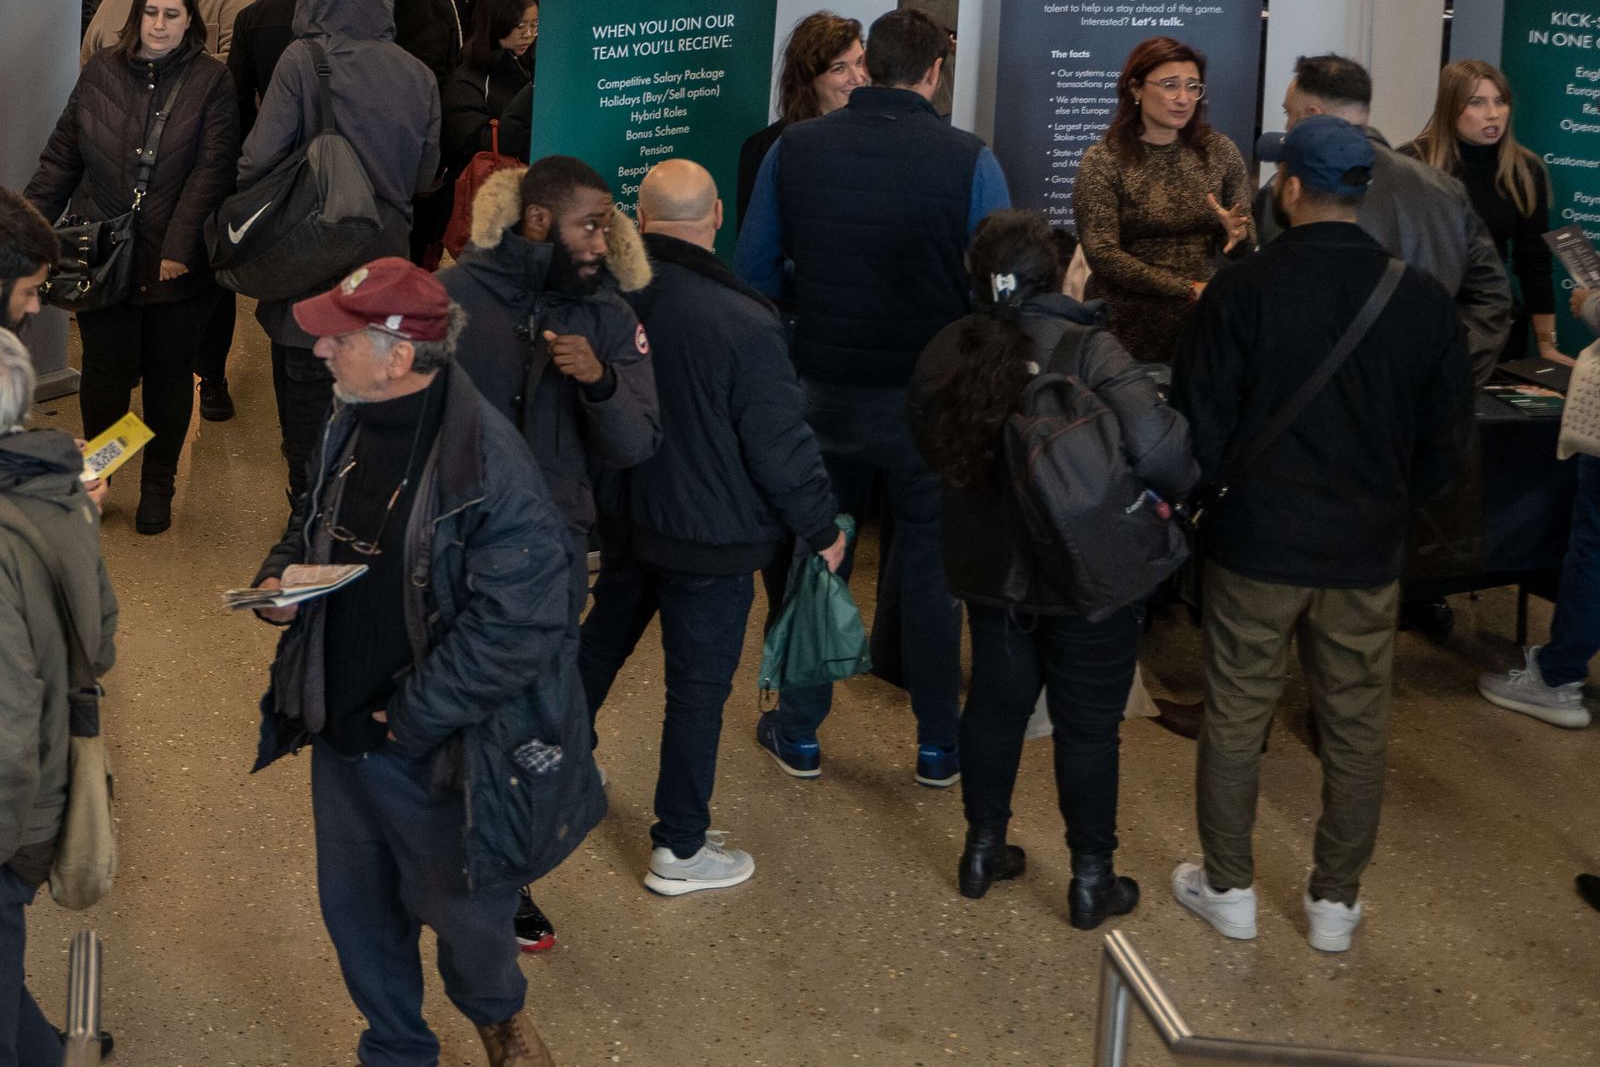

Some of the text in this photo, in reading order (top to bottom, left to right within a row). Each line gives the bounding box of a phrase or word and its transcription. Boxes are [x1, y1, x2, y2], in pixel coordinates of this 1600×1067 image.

[1044, 3, 1224, 16] talent help stay ahead game.
[592, 14, 735, 40] WHEN YOU JOIN OUR
[1080, 17, 1184, 27] Interested? Let's talk.
[1528, 30, 1593, 49] IN ONE
[592, 34, 733, 60] TEAM YOU'LL RECEIVE:
[1051, 49, 1090, 59] The facts
[597, 68, 725, 91] Competitive Salary Package
[1057, 69, 1105, 79] Our systems
[1056, 80, 1103, 88] transactions
[600, 84, 721, 108] Holidays (Buy/Sell option)
[1070, 96, 1097, 104] stream
[630, 106, 688, 124] Hybrid Roles
[1081, 106, 1110, 116] Europe
[626, 125, 690, 141] Bonus Scheme
[1054, 123, 1082, 132] Largest
[640, 144, 674, 157] Pension
